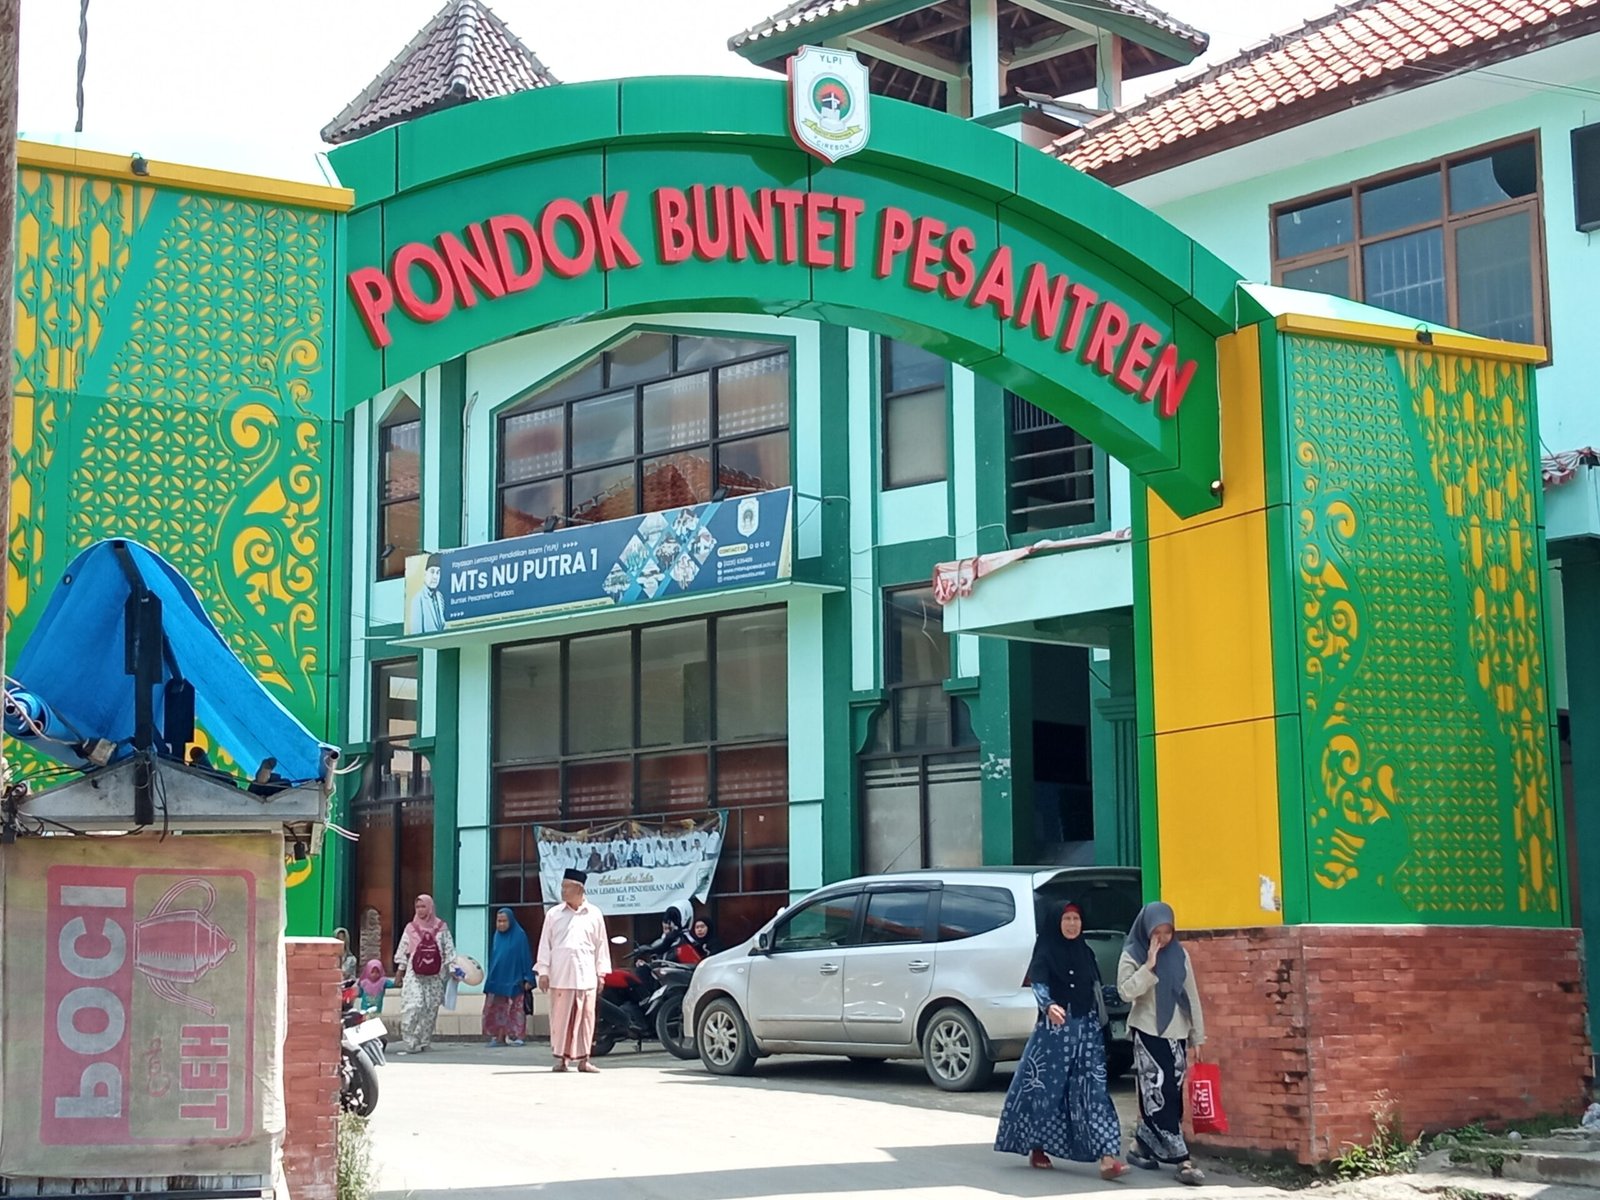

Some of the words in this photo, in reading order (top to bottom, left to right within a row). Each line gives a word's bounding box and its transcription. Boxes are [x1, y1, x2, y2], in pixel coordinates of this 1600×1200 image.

[819, 54, 843, 65] YLPI
[816, 140, 850, 151] CIREBON
[347, 190, 642, 350] PONDOK
[653, 183, 866, 271] BUNTET
[876, 206, 1198, 418] PESANTREN
[450, 569, 488, 594] MTs
[491, 562, 519, 587] NU
[522, 551, 587, 582] PUTRA
[590, 548, 598, 571] 1
[599, 885, 627, 895] LEMBAGA
[627, 882, 666, 893] PENDIDIKAN
[666, 881, 684, 890] ISLAM
